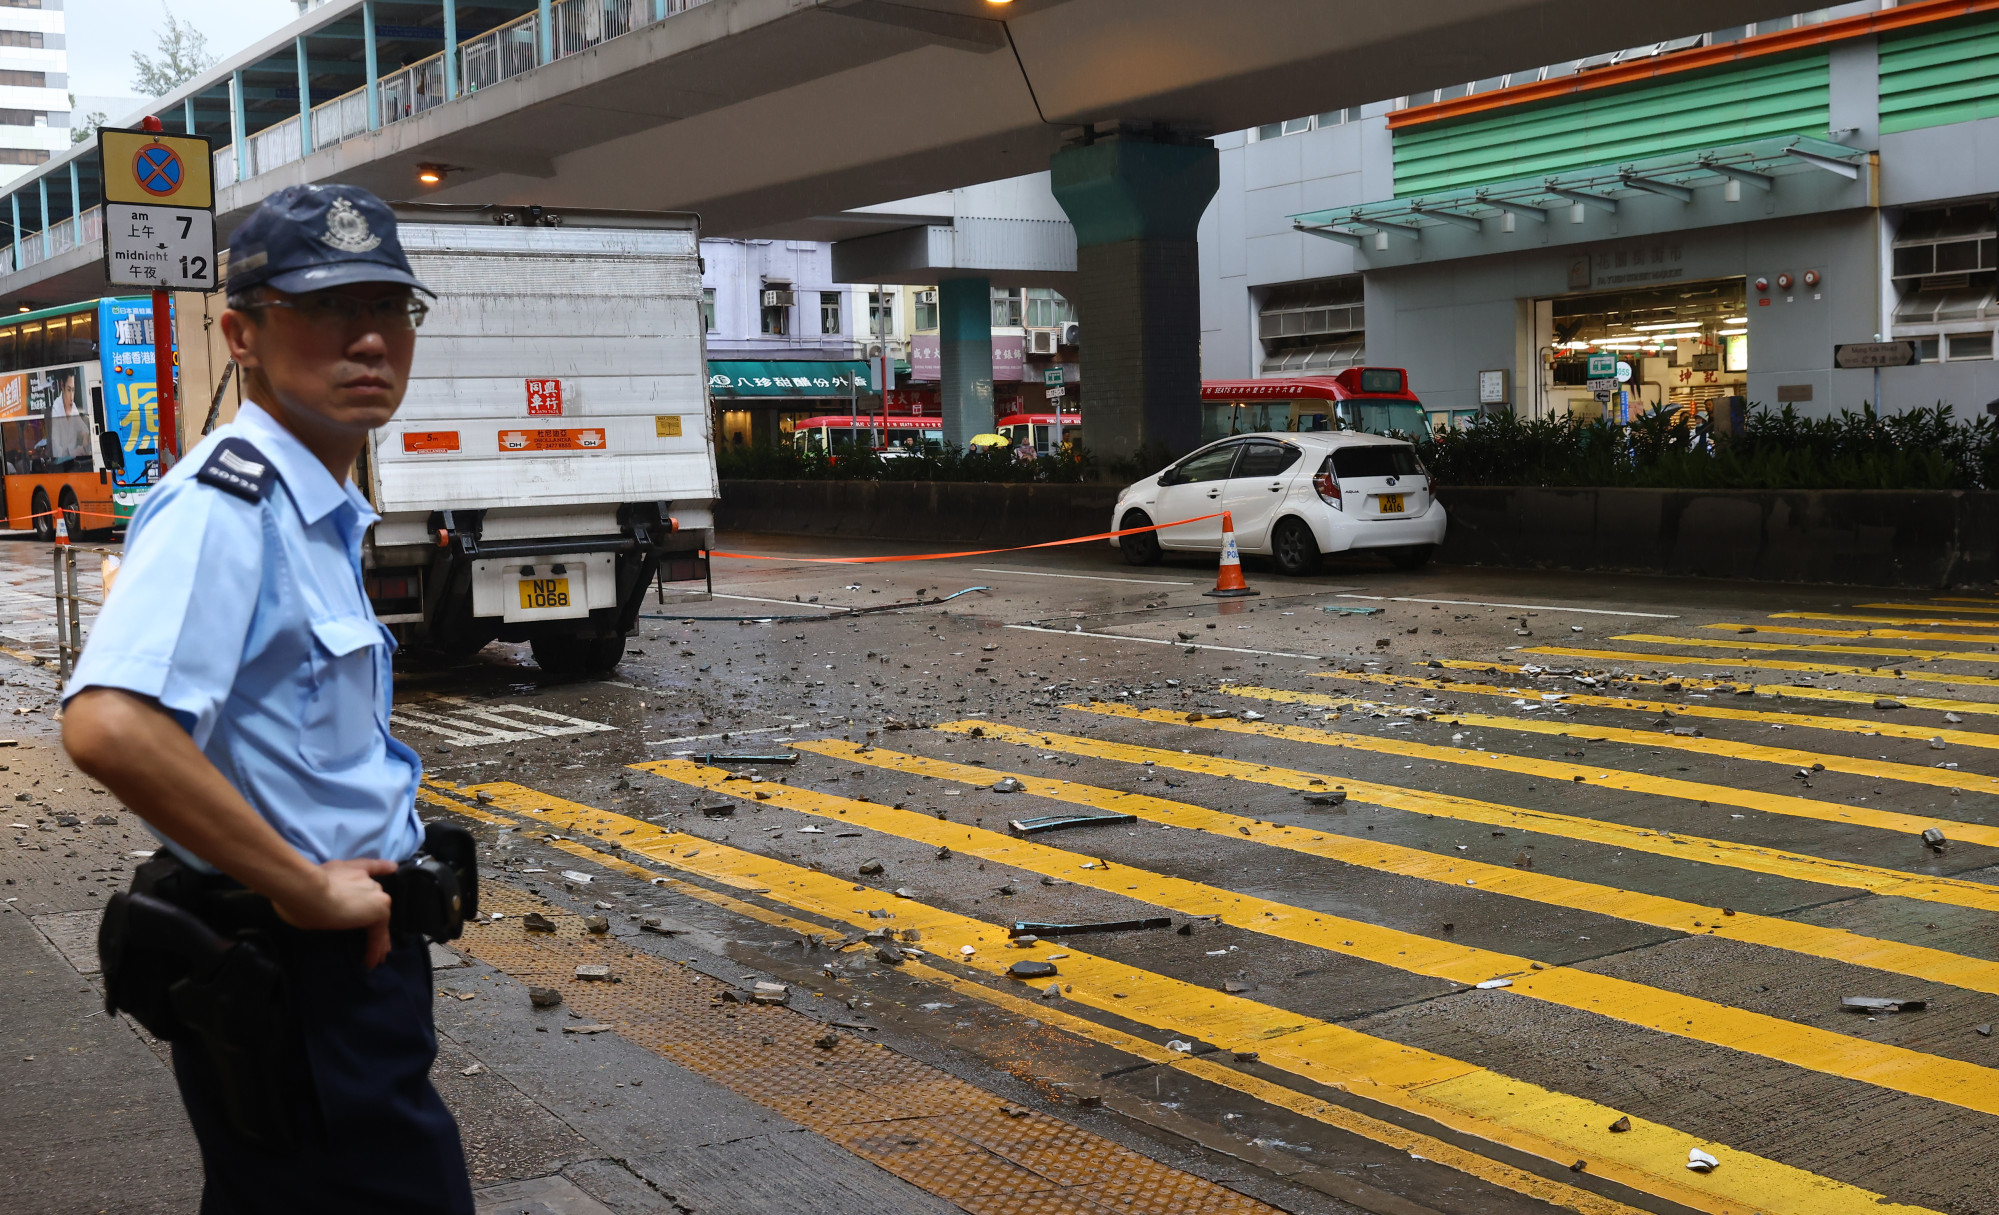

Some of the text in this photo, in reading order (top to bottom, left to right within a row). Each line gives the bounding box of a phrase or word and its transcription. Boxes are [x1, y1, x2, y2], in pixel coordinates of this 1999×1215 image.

[131, 212, 149, 221] am
[127, 224, 155, 239] 上午
[176, 215, 193, 240] 7
[115, 249, 169, 262] midnight
[129, 264, 157, 279] 午夜
[178, 255, 208, 280] 12
[426, 433, 439, 442] 5m
[1386, 494, 1397, 504] XB
[1382, 503, 1402, 513] 4416
[533, 579, 557, 594] ND
[527, 592, 568, 608] 1068
